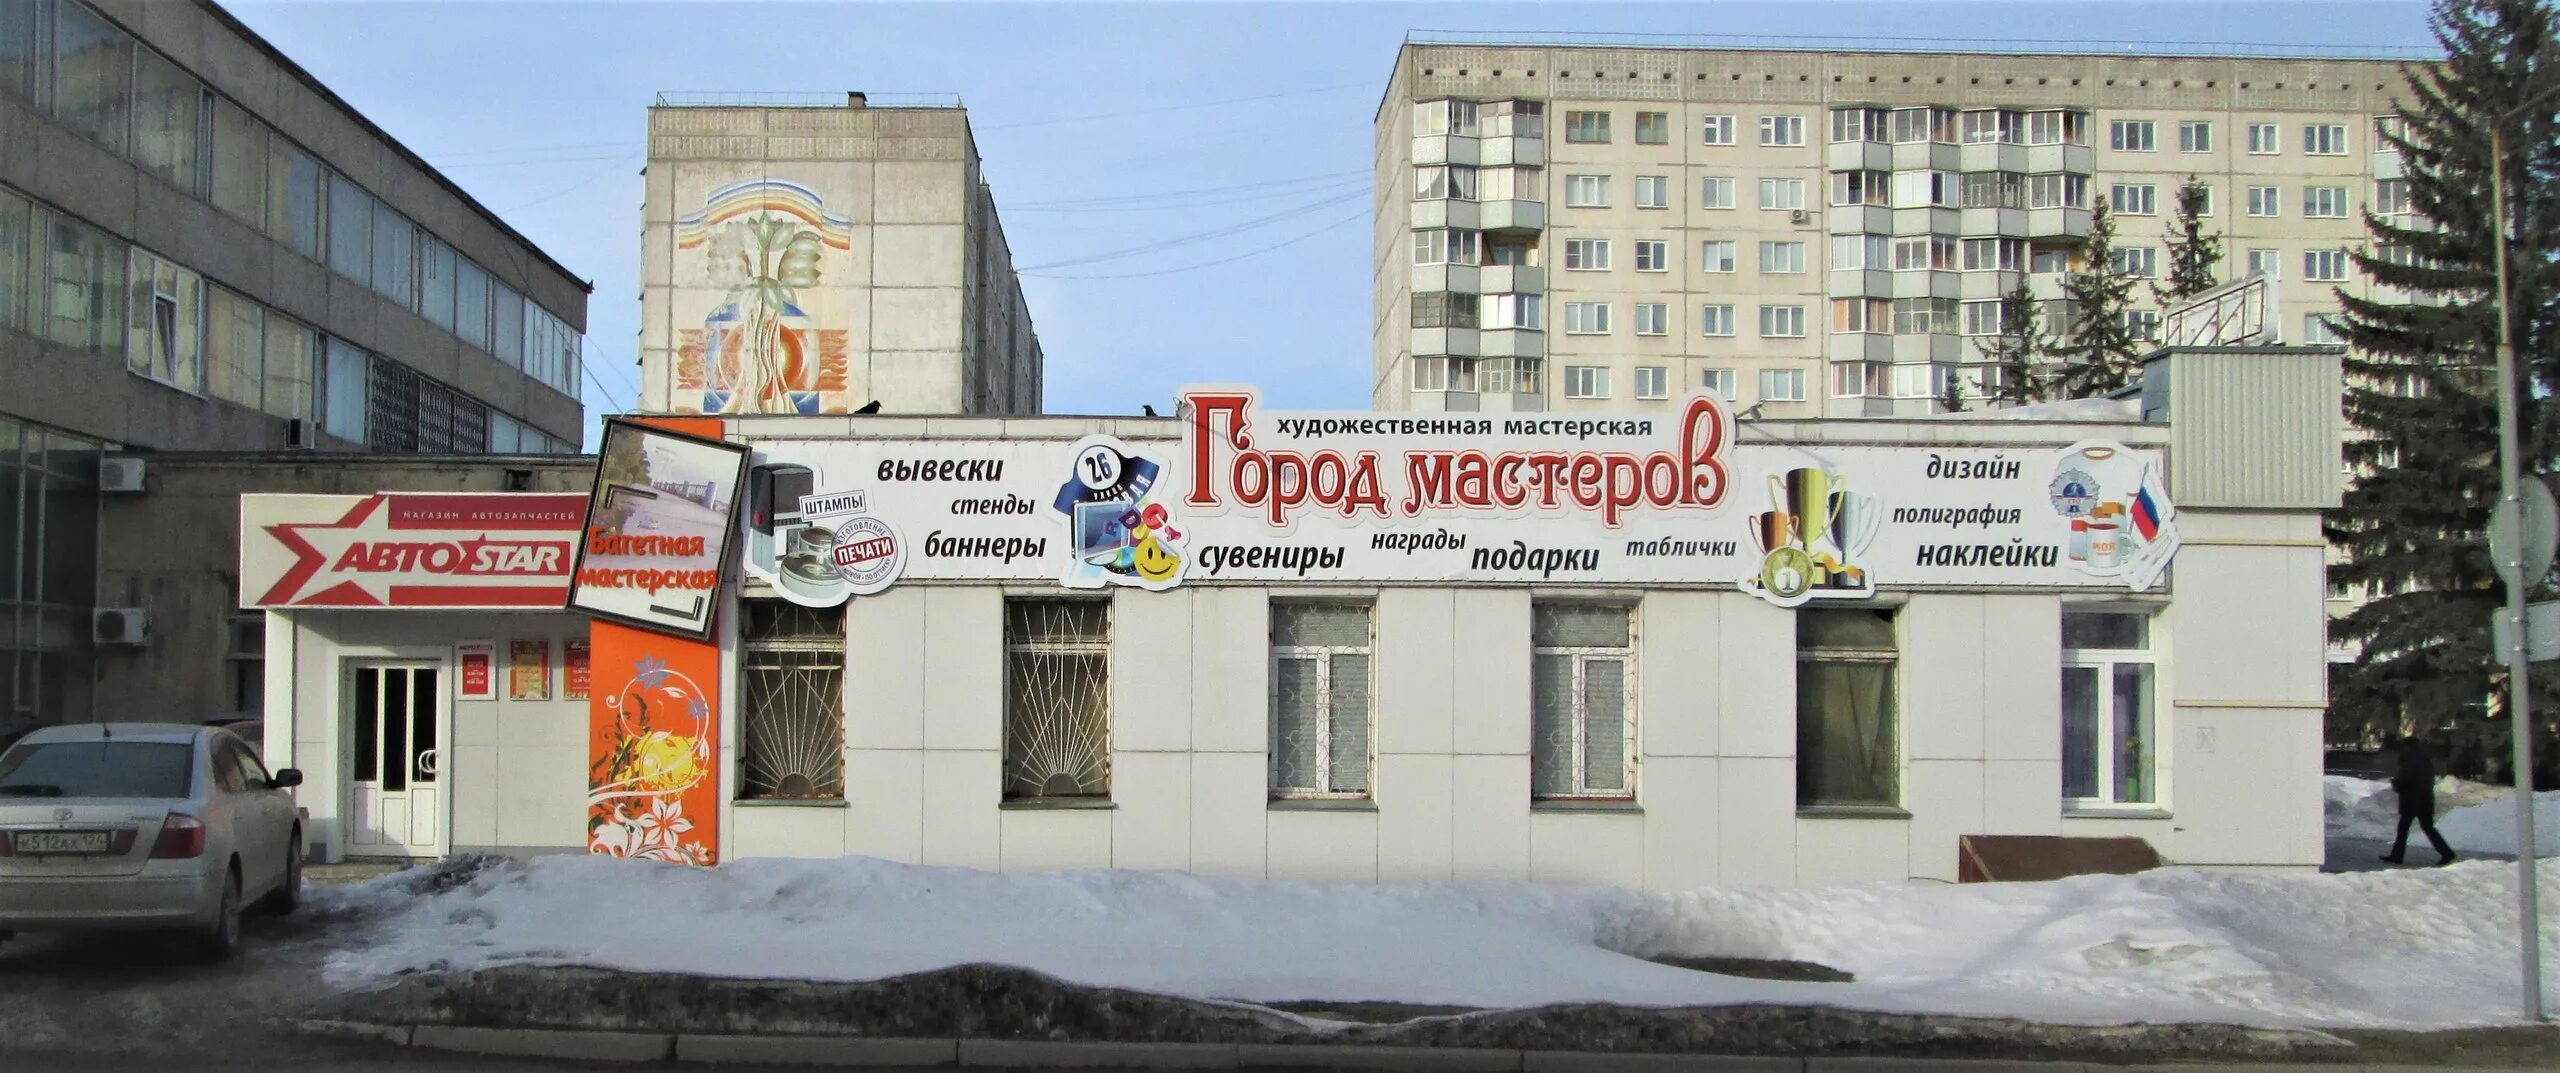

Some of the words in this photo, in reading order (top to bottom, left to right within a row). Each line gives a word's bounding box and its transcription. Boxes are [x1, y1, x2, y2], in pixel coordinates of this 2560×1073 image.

[1277, 416, 1492, 437] художественная
[1504, 416, 1653, 440] мастерская
[877, 457, 1004, 483] вывески
[1085, 452, 1113, 484] 26
[1184, 395, 1391, 527] Город
[1405, 395, 1728, 527] мастеров
[1926, 454, 2021, 480] дизайн
[403, 510, 460, 521] МАГАЗИН
[471, 509, 576, 521] АВТОЗАПЧАСТЕЙ
[805, 495, 864, 515] ШТАМПЫ
[951, 494, 1035, 518] стенды
[1892, 503, 2021, 529] полиграфия
[589, 525, 705, 557] Багетная
[836, 522, 887, 545] ИЗГОТОВЛЕНИЕ
[1371, 529, 1467, 552] награды
[838, 539, 892, 564] ПЕЧАТИ
[924, 530, 1047, 564] баннеры
[1197, 541, 1345, 575] сувениры
[1472, 540, 1601, 577] подарки
[1626, 536, 1738, 558] таблички
[1916, 539, 2059, 567] наклейки
[576, 567, 719, 595] мастерская
